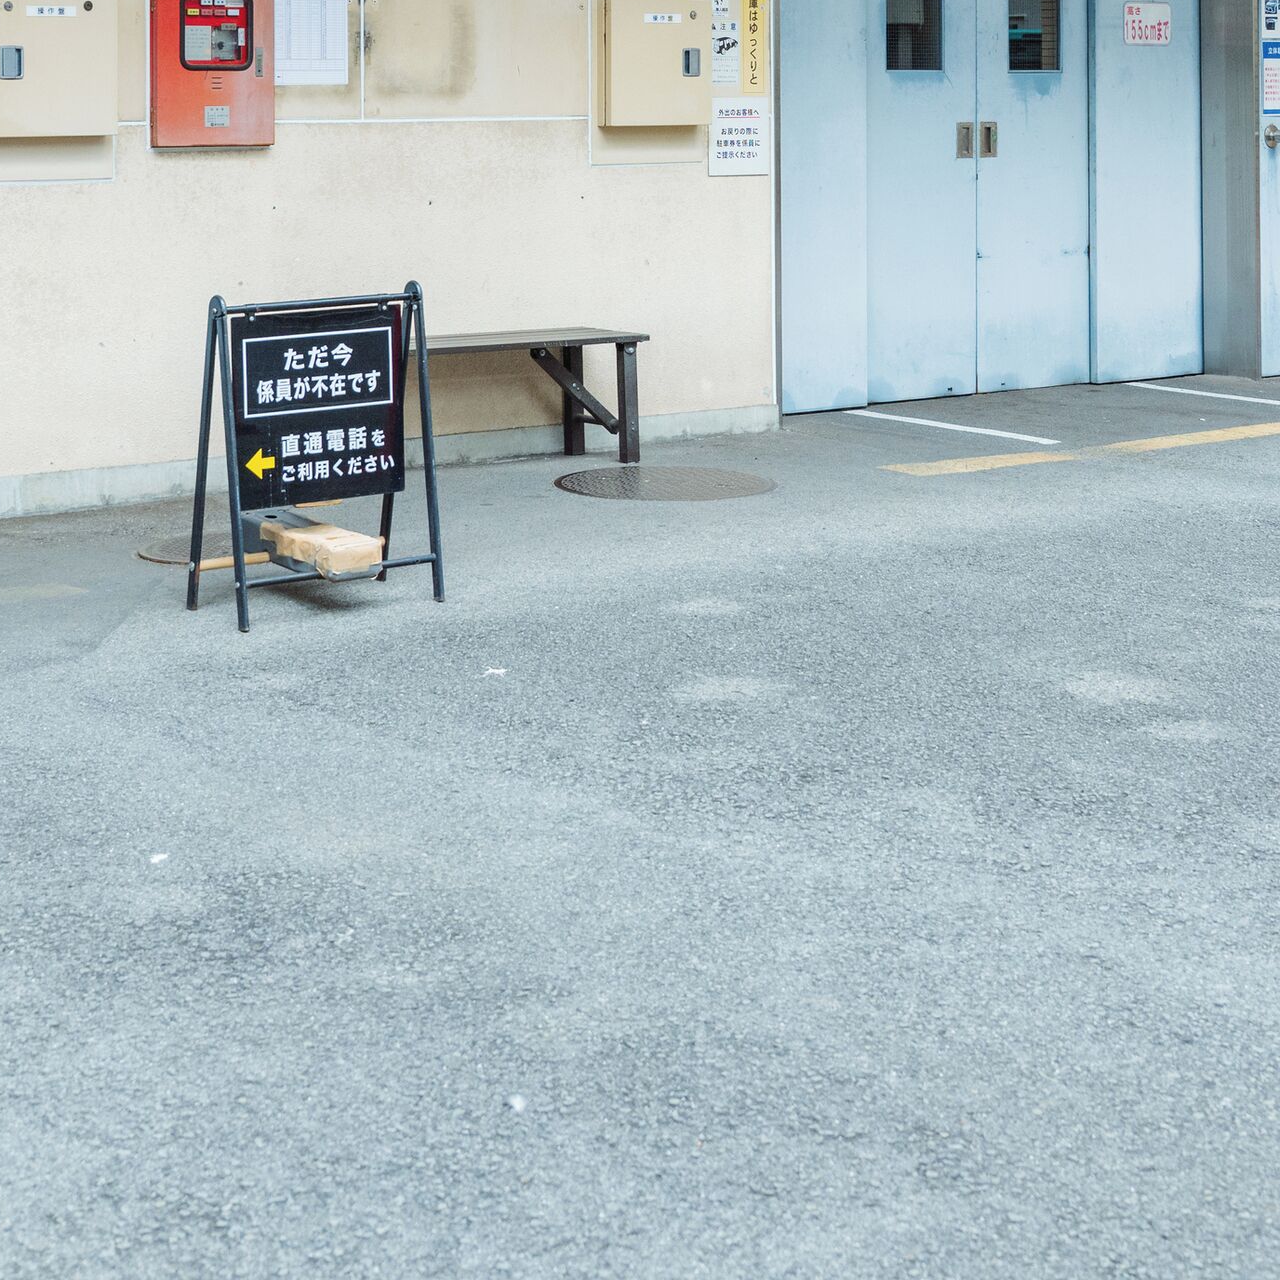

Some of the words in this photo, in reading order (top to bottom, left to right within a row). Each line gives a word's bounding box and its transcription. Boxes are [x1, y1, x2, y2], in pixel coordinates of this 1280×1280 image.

[37, 7, 65, 16] 操作盤
[1126, 6, 1141, 16] 高さ
[720, 23, 737, 31] 注意
[1125, 19, 1169, 41] 155cmまで
[718, 108, 760, 117] 外出のお客様へ
[721, 127, 759, 135] お戻りの際に
[716, 139, 761, 148] 駐車券を係員に
[716, 150, 758, 159] ご提示ください
[283, 342, 354, 371] ただ今
[256, 370, 381, 404] 係員が不在です
[281, 426, 386, 458] 直通電話を
[281, 454, 396, 483] ご利用ください
